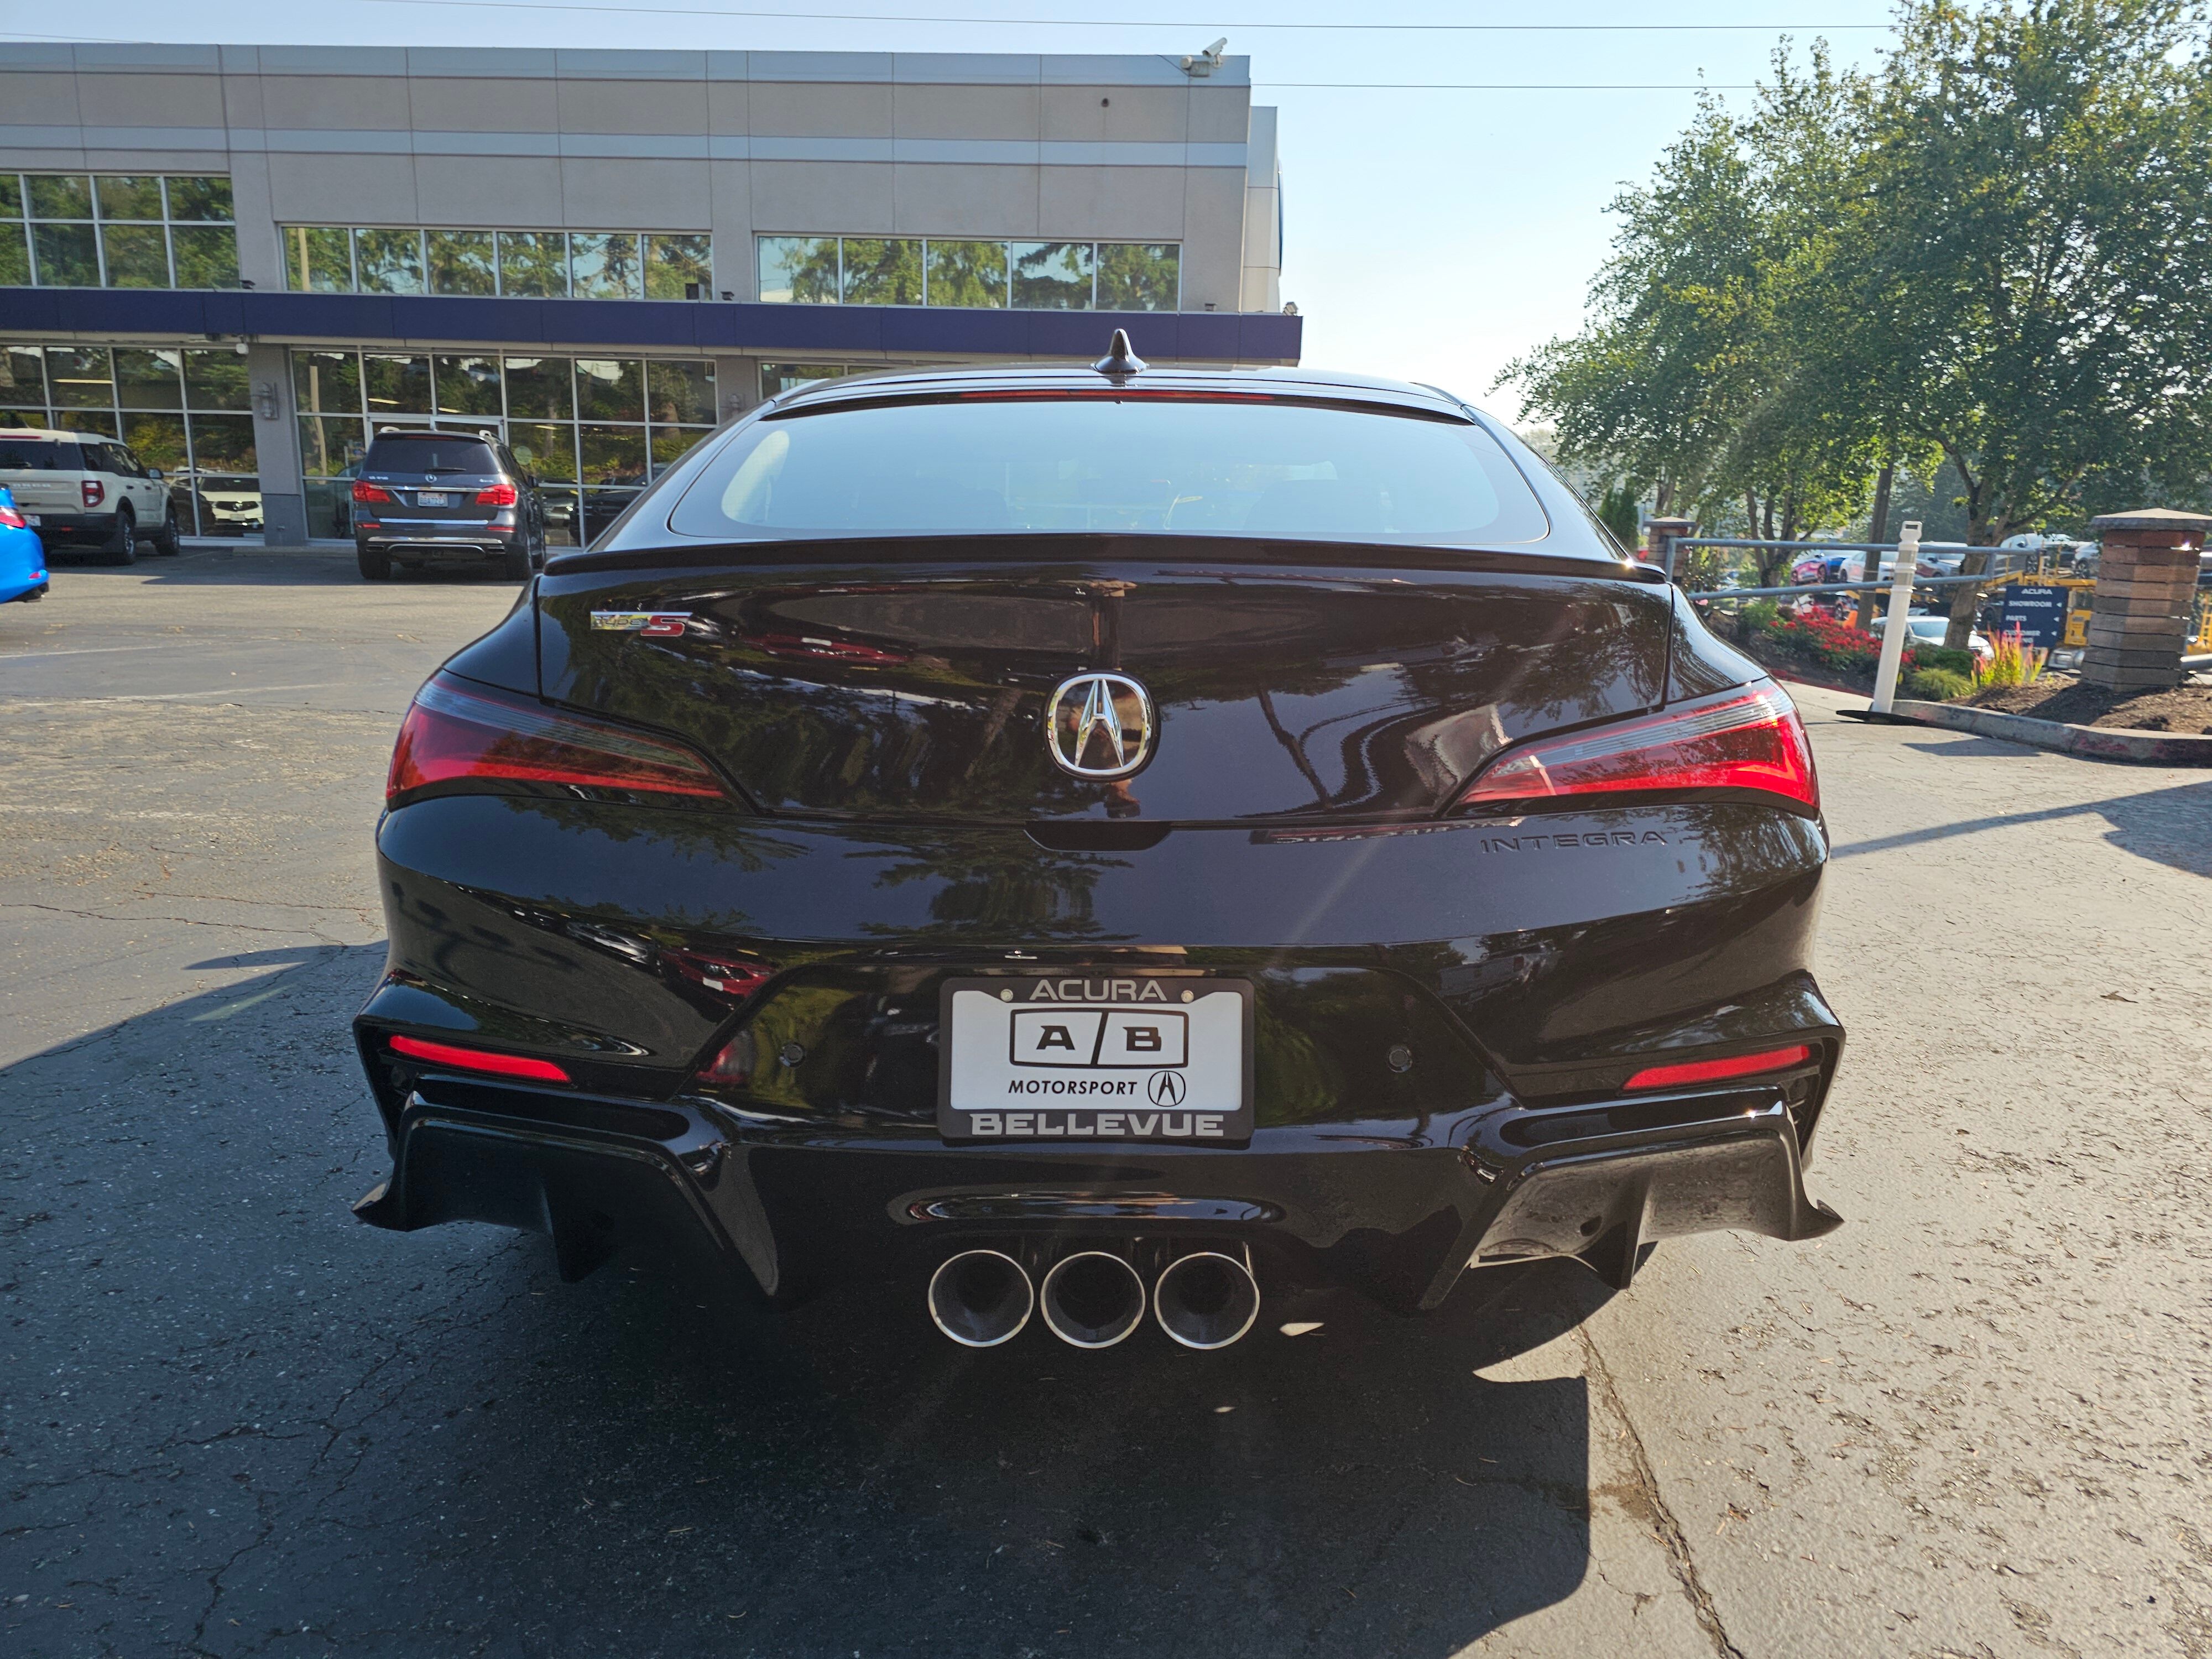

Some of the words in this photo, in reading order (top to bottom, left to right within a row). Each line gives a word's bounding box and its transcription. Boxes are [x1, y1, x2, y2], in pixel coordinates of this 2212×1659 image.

[640, 613, 690, 637] S
[1480, 831, 1668, 854] INTEGRA
[1029, 979, 1167, 1001] ACURA
[1036, 1025, 1076, 1051] A
[1122, 1026, 1162, 1051] B
[1008, 1080, 1138, 1095] MOTORSPORT
[969, 1113, 1224, 1136] BELLEVUE
